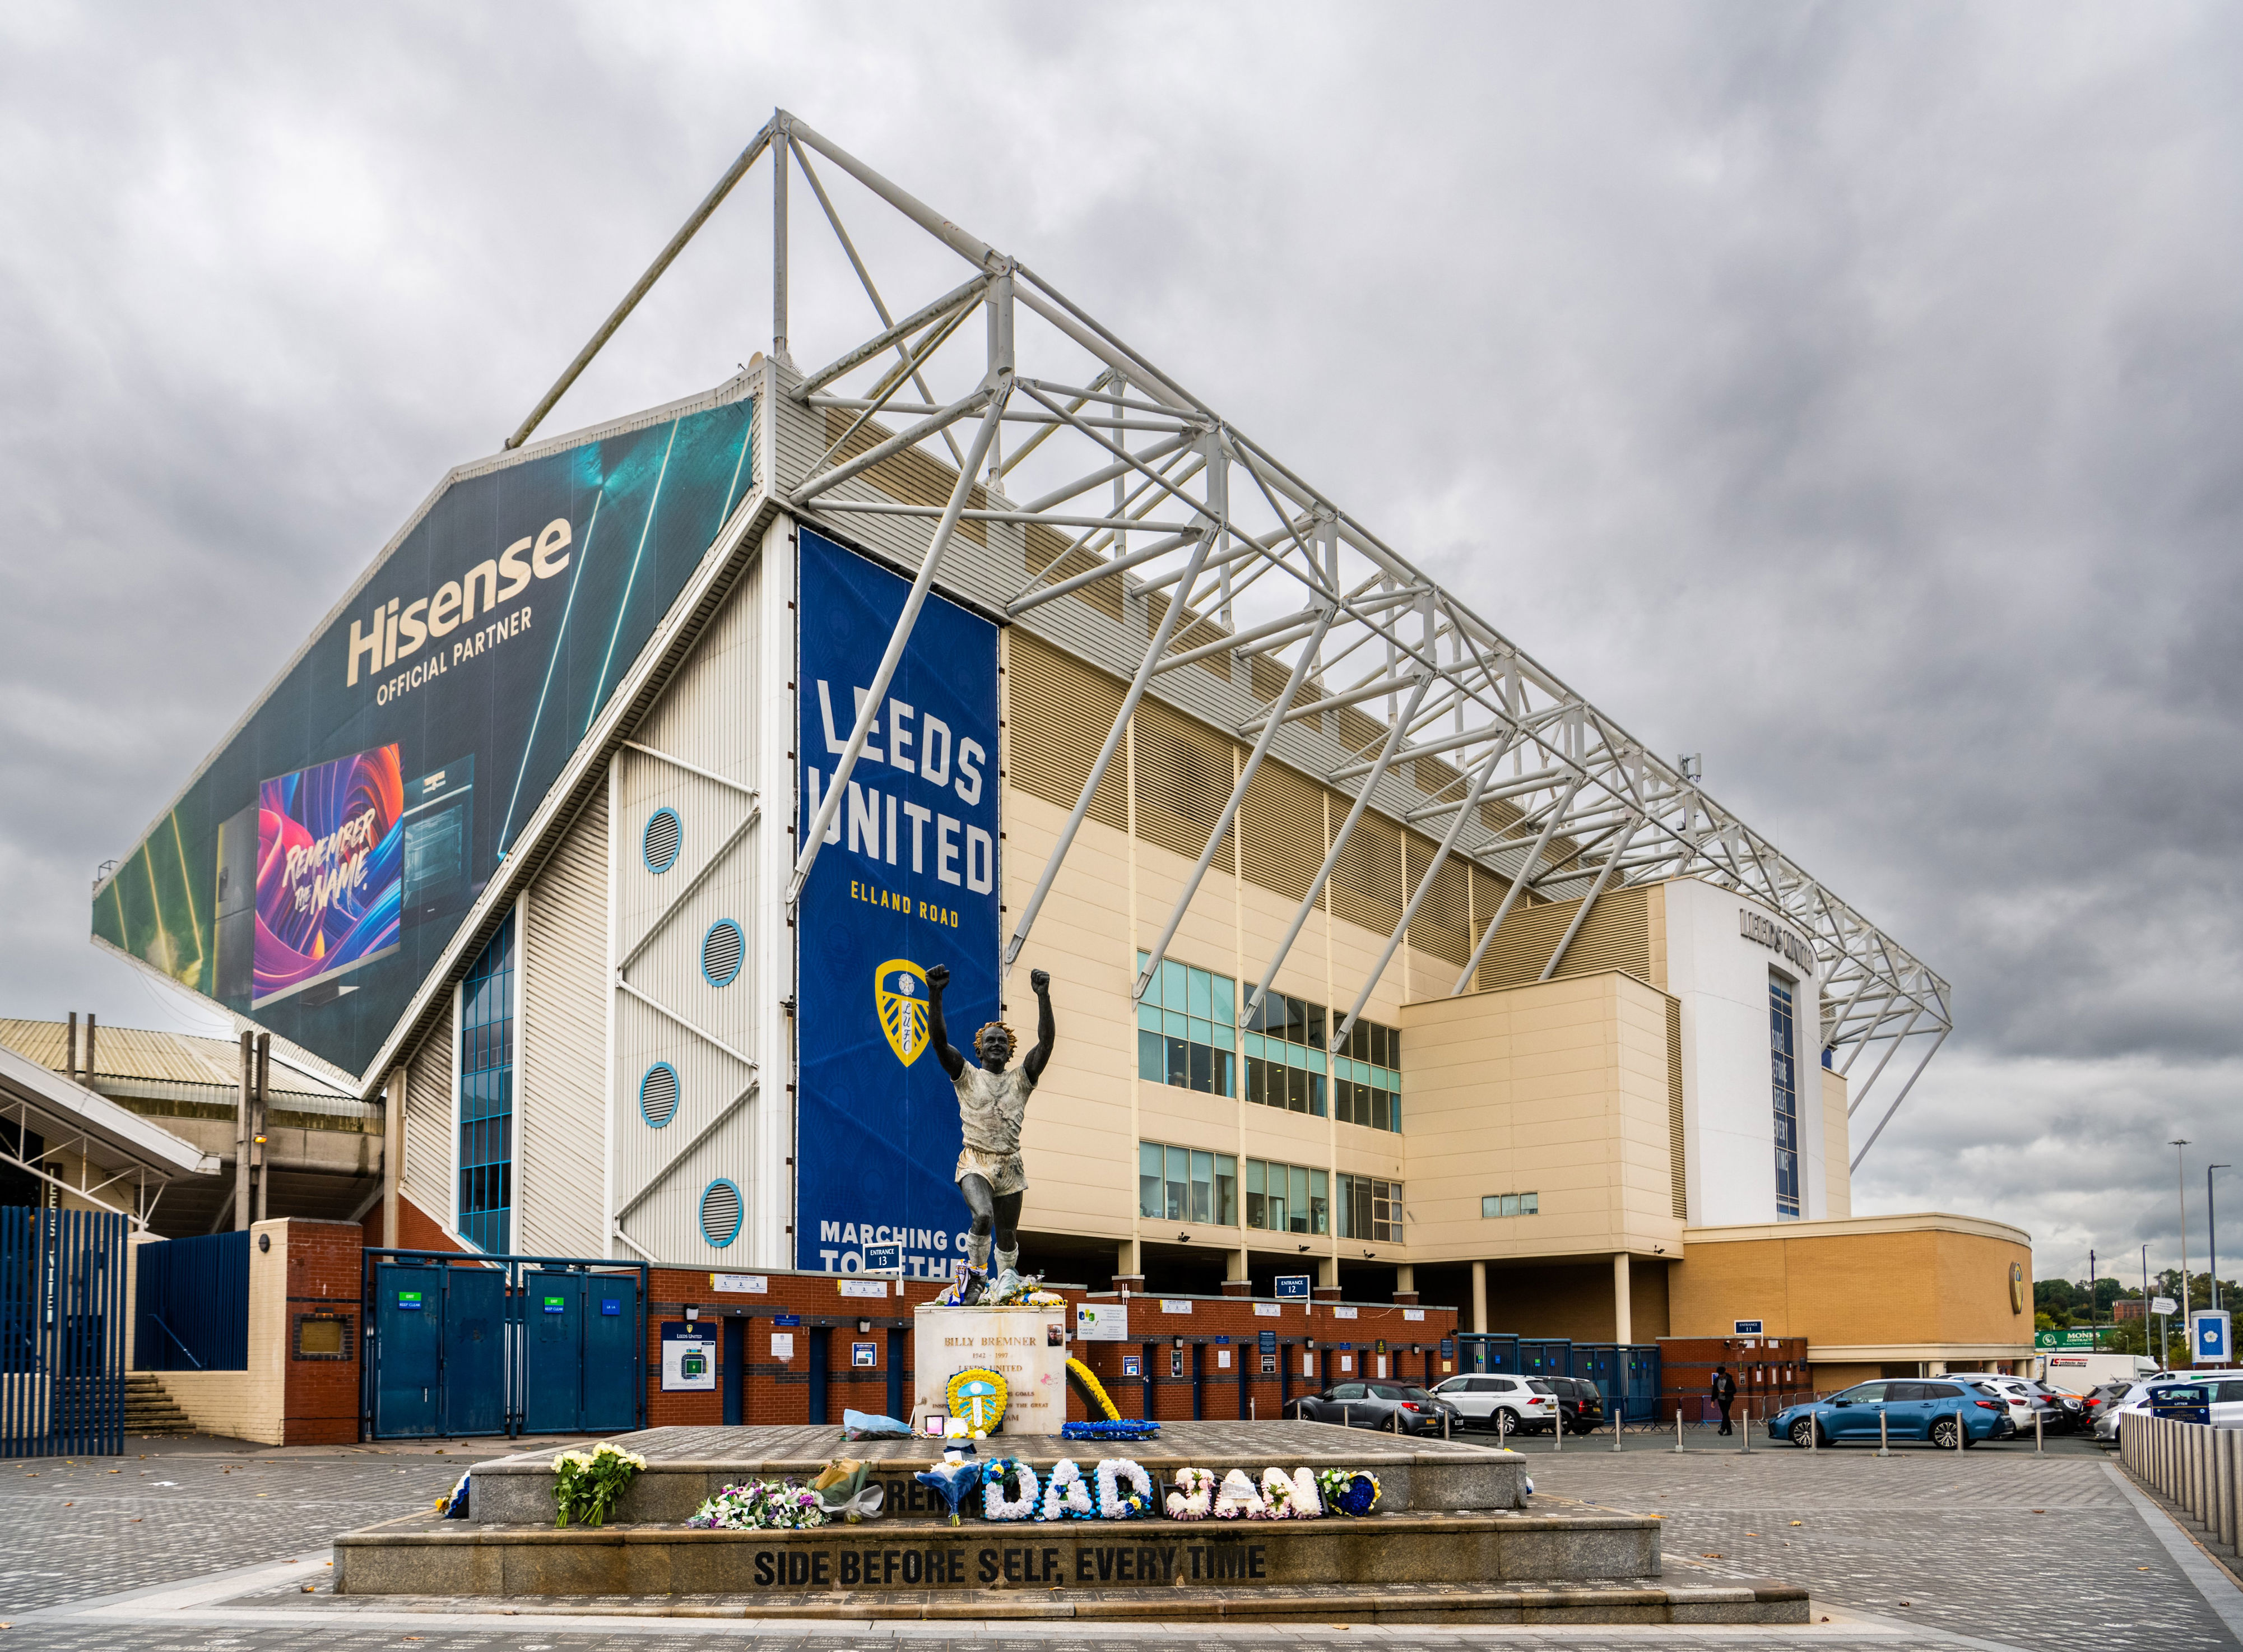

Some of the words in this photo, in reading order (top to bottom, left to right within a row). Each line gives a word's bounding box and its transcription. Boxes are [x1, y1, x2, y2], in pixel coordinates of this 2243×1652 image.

[346, 518, 572, 687] Hisense
[376, 657, 447, 707] OFFICIAL
[453, 606, 532, 666] PARTNER
[817, 679, 986, 806] LEEDS
[282, 808, 375, 892] REMEMBER
[851, 880, 911, 915] ELLAND
[920, 901, 959, 929] ROAD
[1739, 908, 1783, 953] LEEDS
[1772, 1029, 1784, 1052] SIDE
[1772, 1057, 1787, 1083] EFORE
[1775, 1088, 1785, 1111] SELF
[821, 1220, 948, 1251] MARCHING
[879, 1256, 888, 1266] 13
[945, 1337, 974, 1346] BILLY
[981, 1337, 1036, 1346] BREMNER
[981, 1457, 1154, 1521] DAD
[754, 1551, 830, 1586] SIDE
[840, 1549, 965, 1584] BEFORE
[978, 1548, 1064, 1586] SELF,
[1076, 1546, 1176, 1580] EVERY
[1187, 1545, 1266, 1579] TIME
